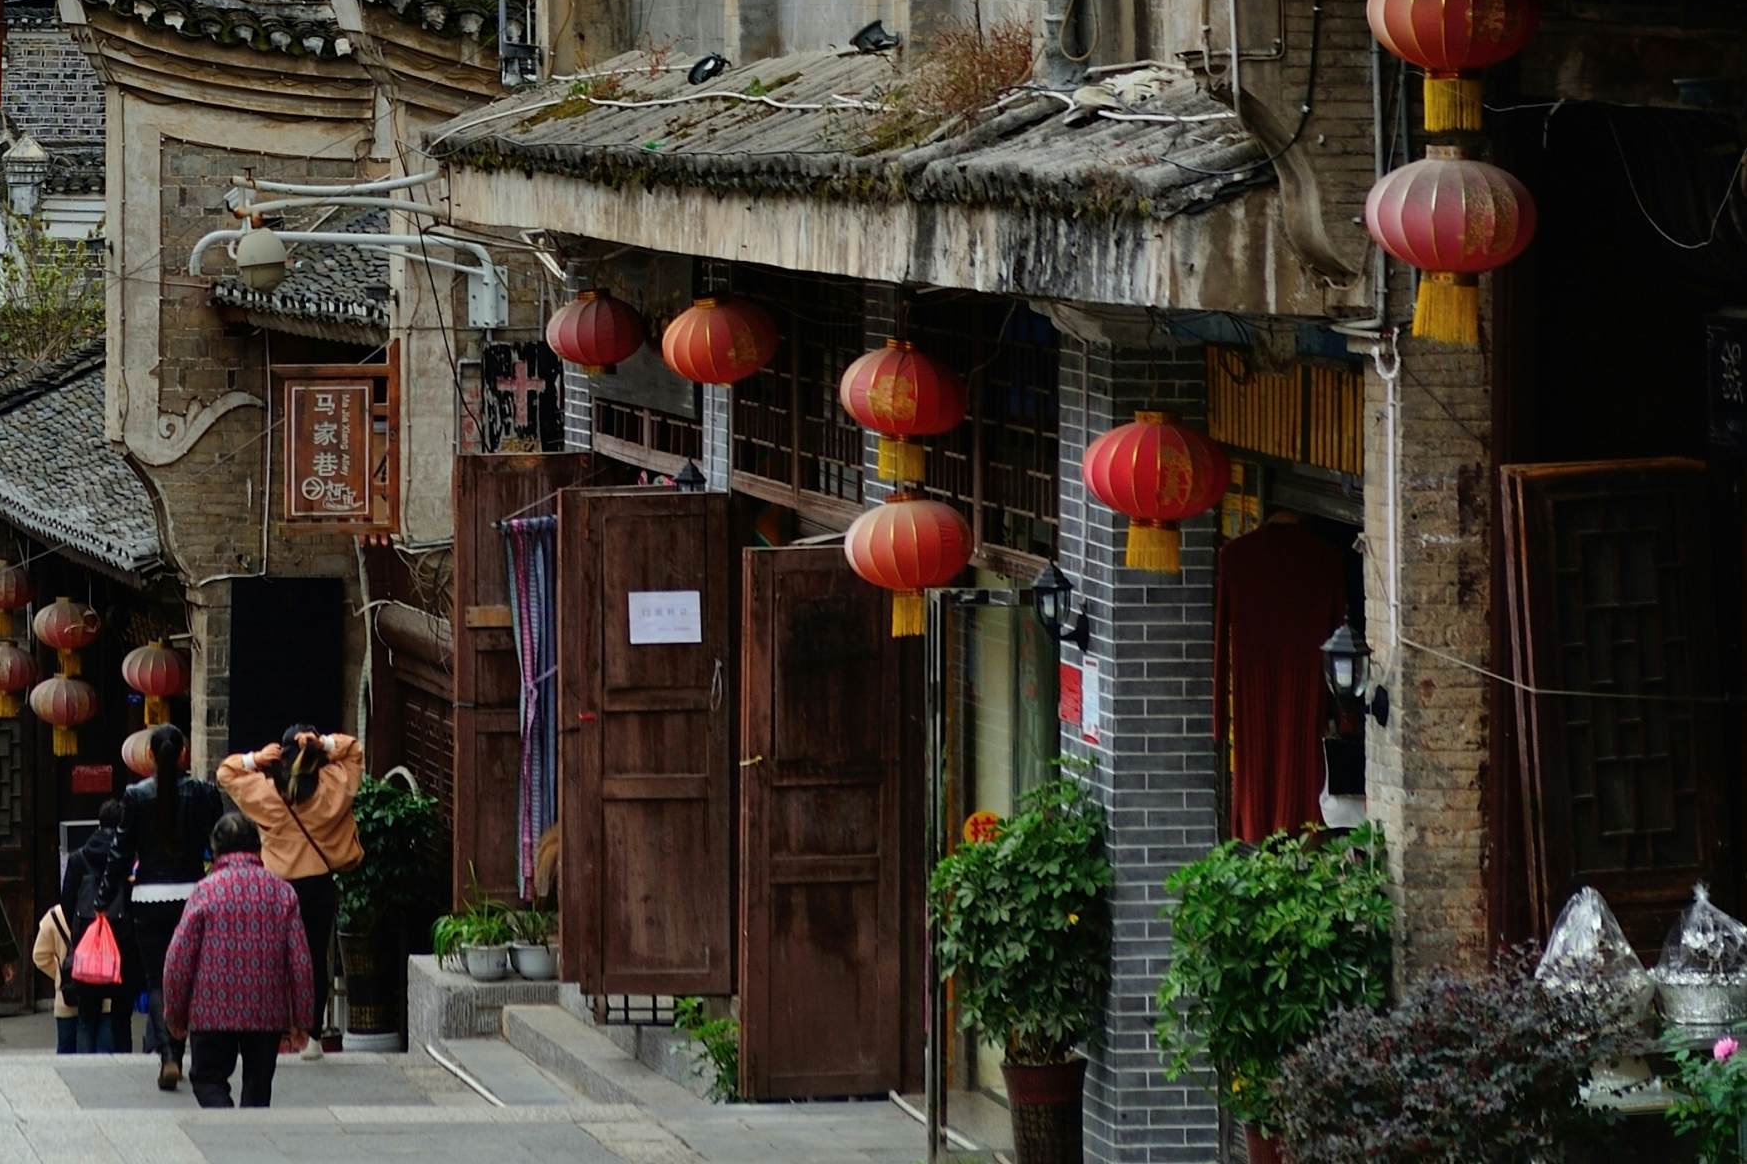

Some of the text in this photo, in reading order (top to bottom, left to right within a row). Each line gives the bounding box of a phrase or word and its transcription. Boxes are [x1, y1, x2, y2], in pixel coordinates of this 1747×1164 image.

[312, 393, 338, 477] 马家巷
[340, 453, 351, 476] Alley
